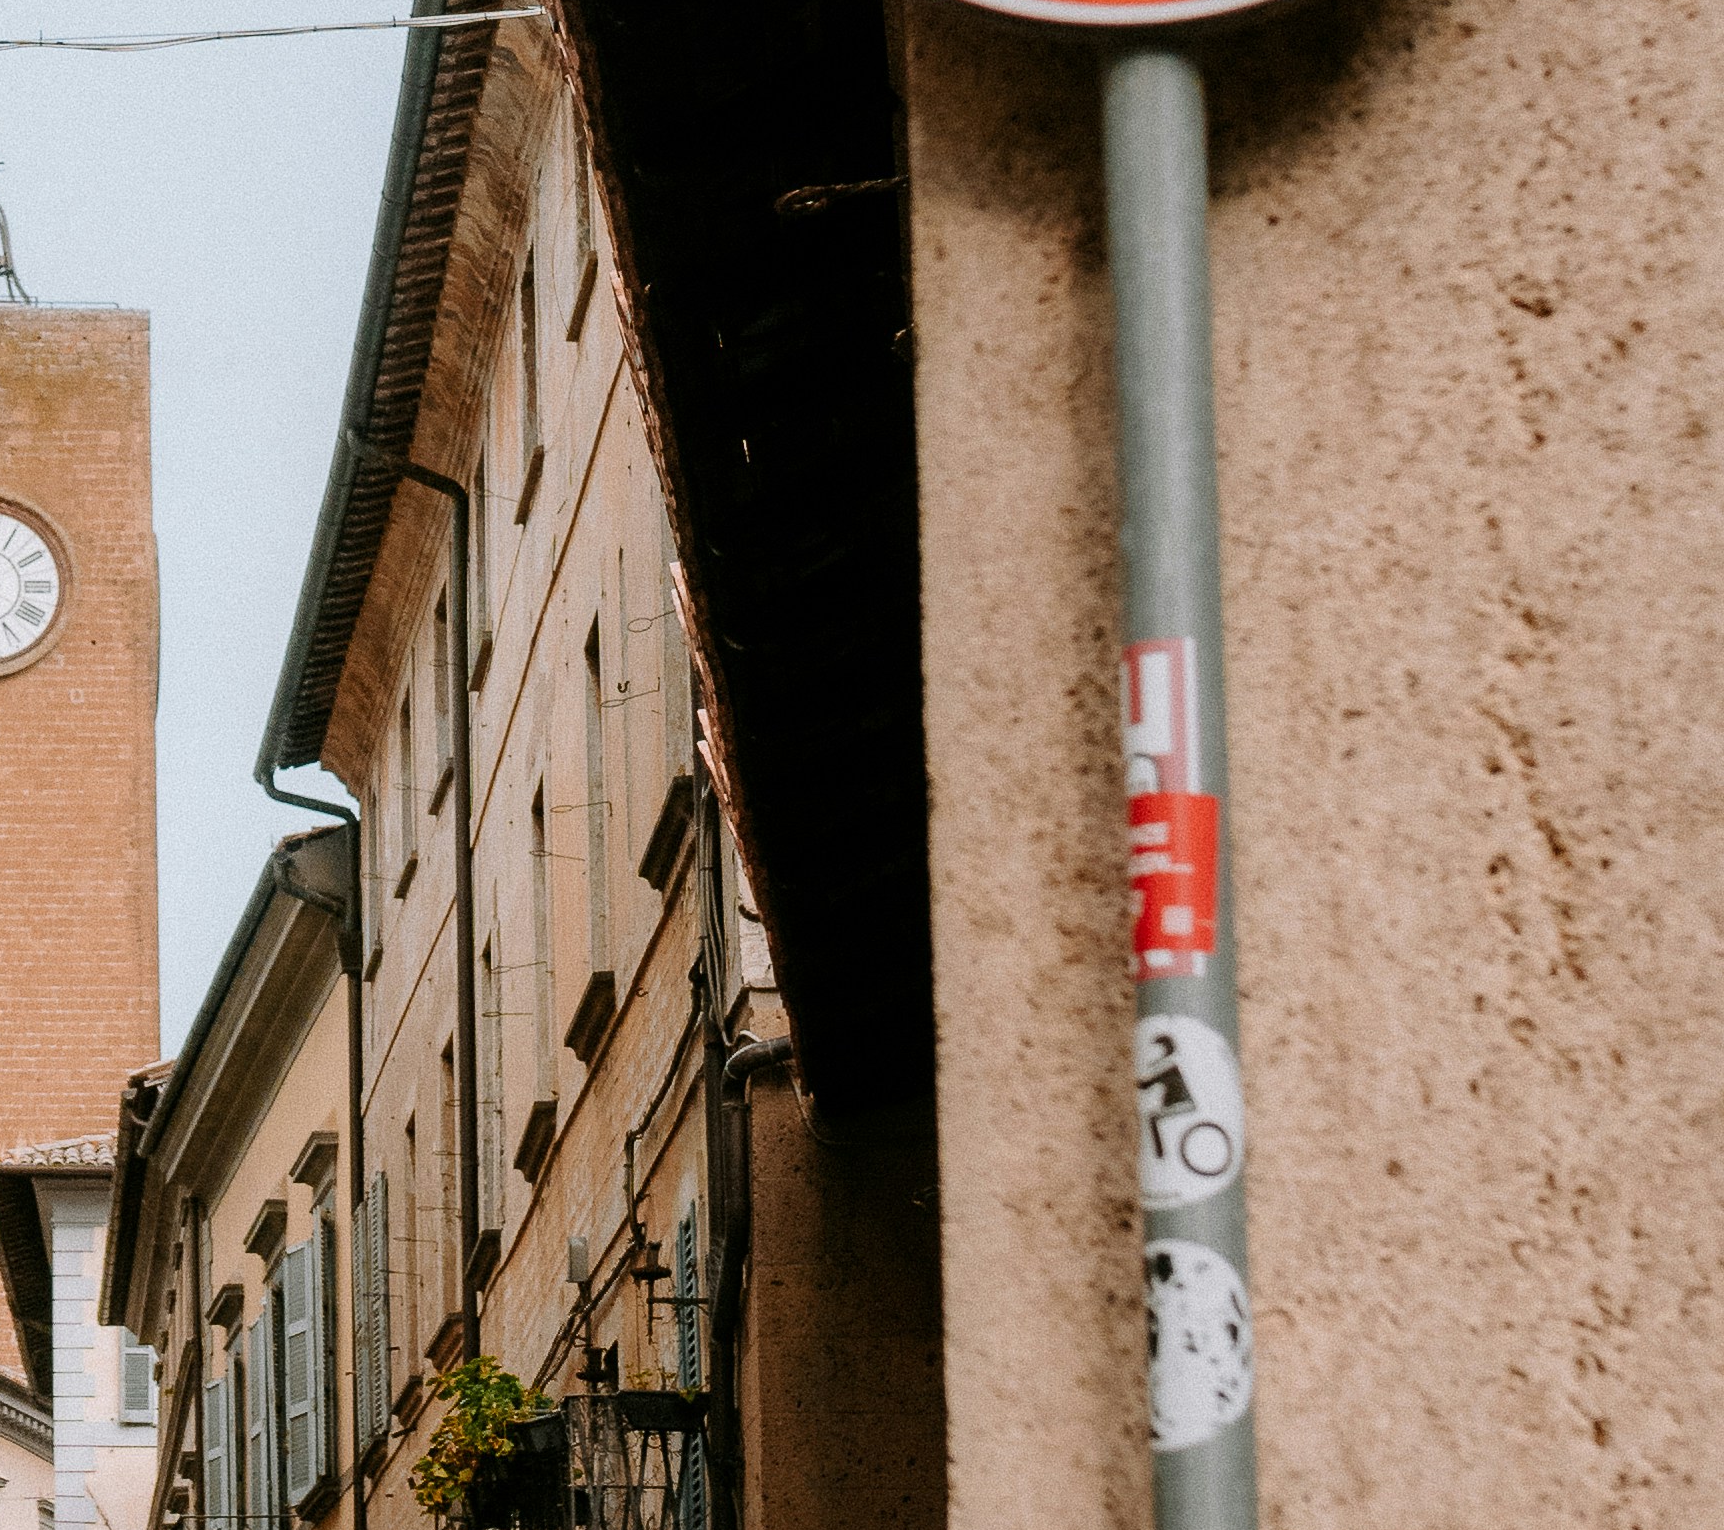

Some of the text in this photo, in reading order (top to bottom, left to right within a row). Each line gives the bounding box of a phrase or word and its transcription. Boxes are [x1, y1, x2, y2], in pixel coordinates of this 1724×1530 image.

[3, 528, 17, 550] I
[17, 550, 43, 568] II
[24, 580, 51, 593] III
